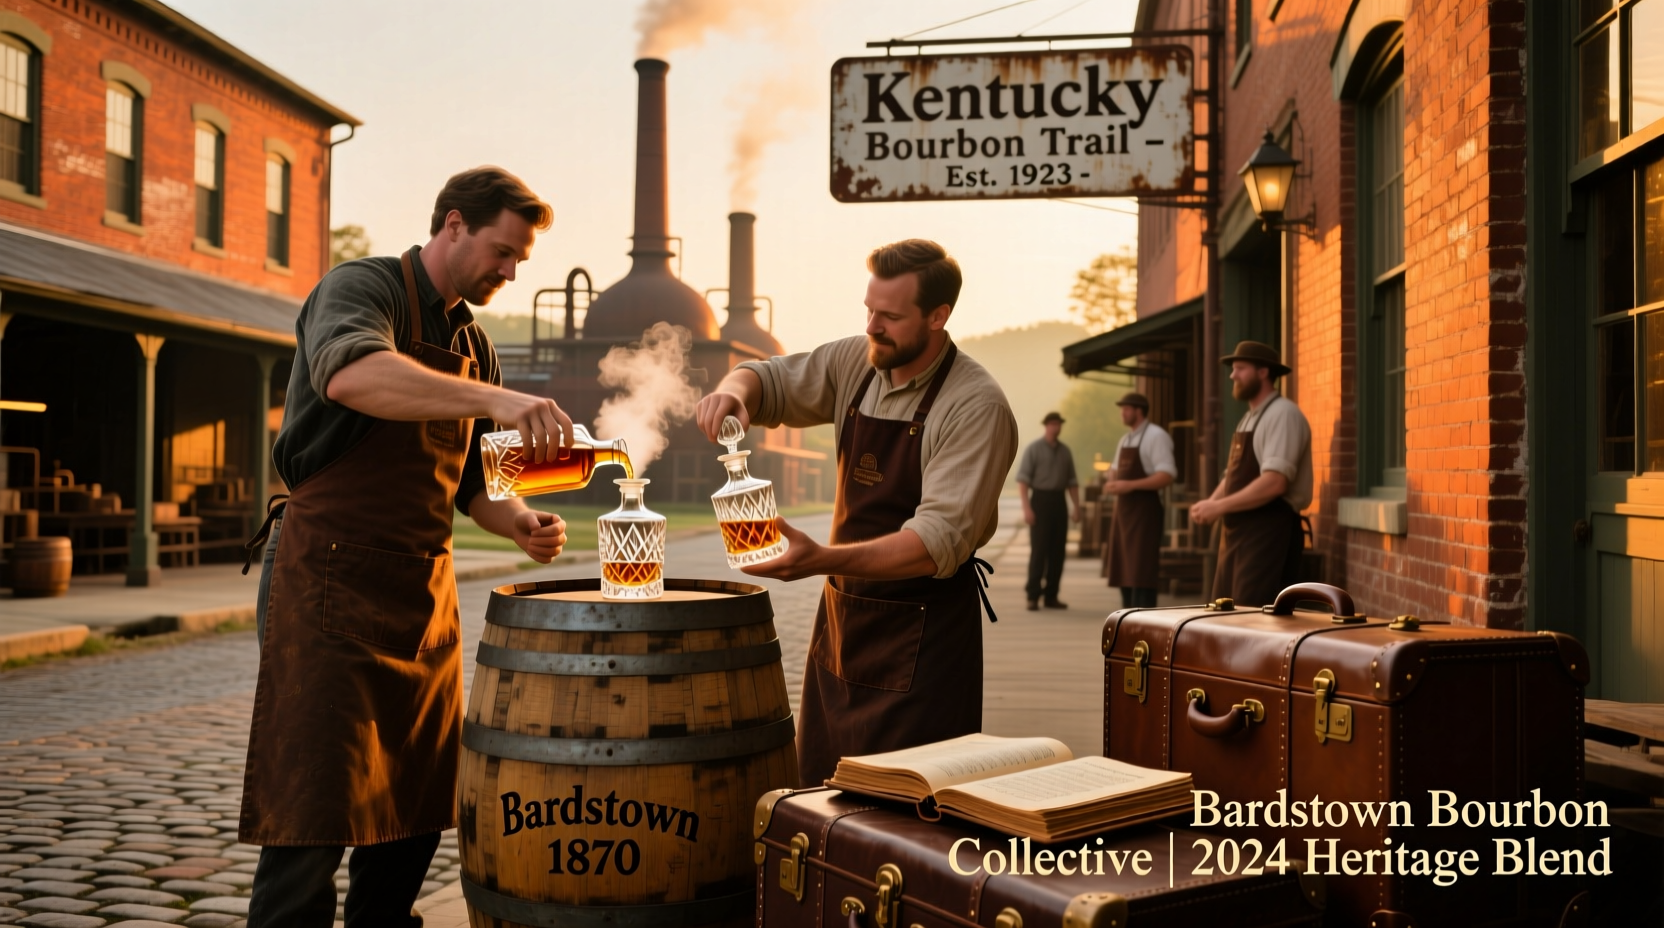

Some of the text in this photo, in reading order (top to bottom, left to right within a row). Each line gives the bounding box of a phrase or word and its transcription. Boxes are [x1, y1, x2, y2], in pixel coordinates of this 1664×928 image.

[862, 65, 1164, 128] Kentucky
[864, 128, 1025, 160] Bourbon
[1040, 123, 1130, 156] Trail
[946, 165, 997, 187] Est.
[1010, 163, 1072, 187] 1923
[500, 784, 700, 843] Bardstown
[547, 838, 641, 876] 1870
